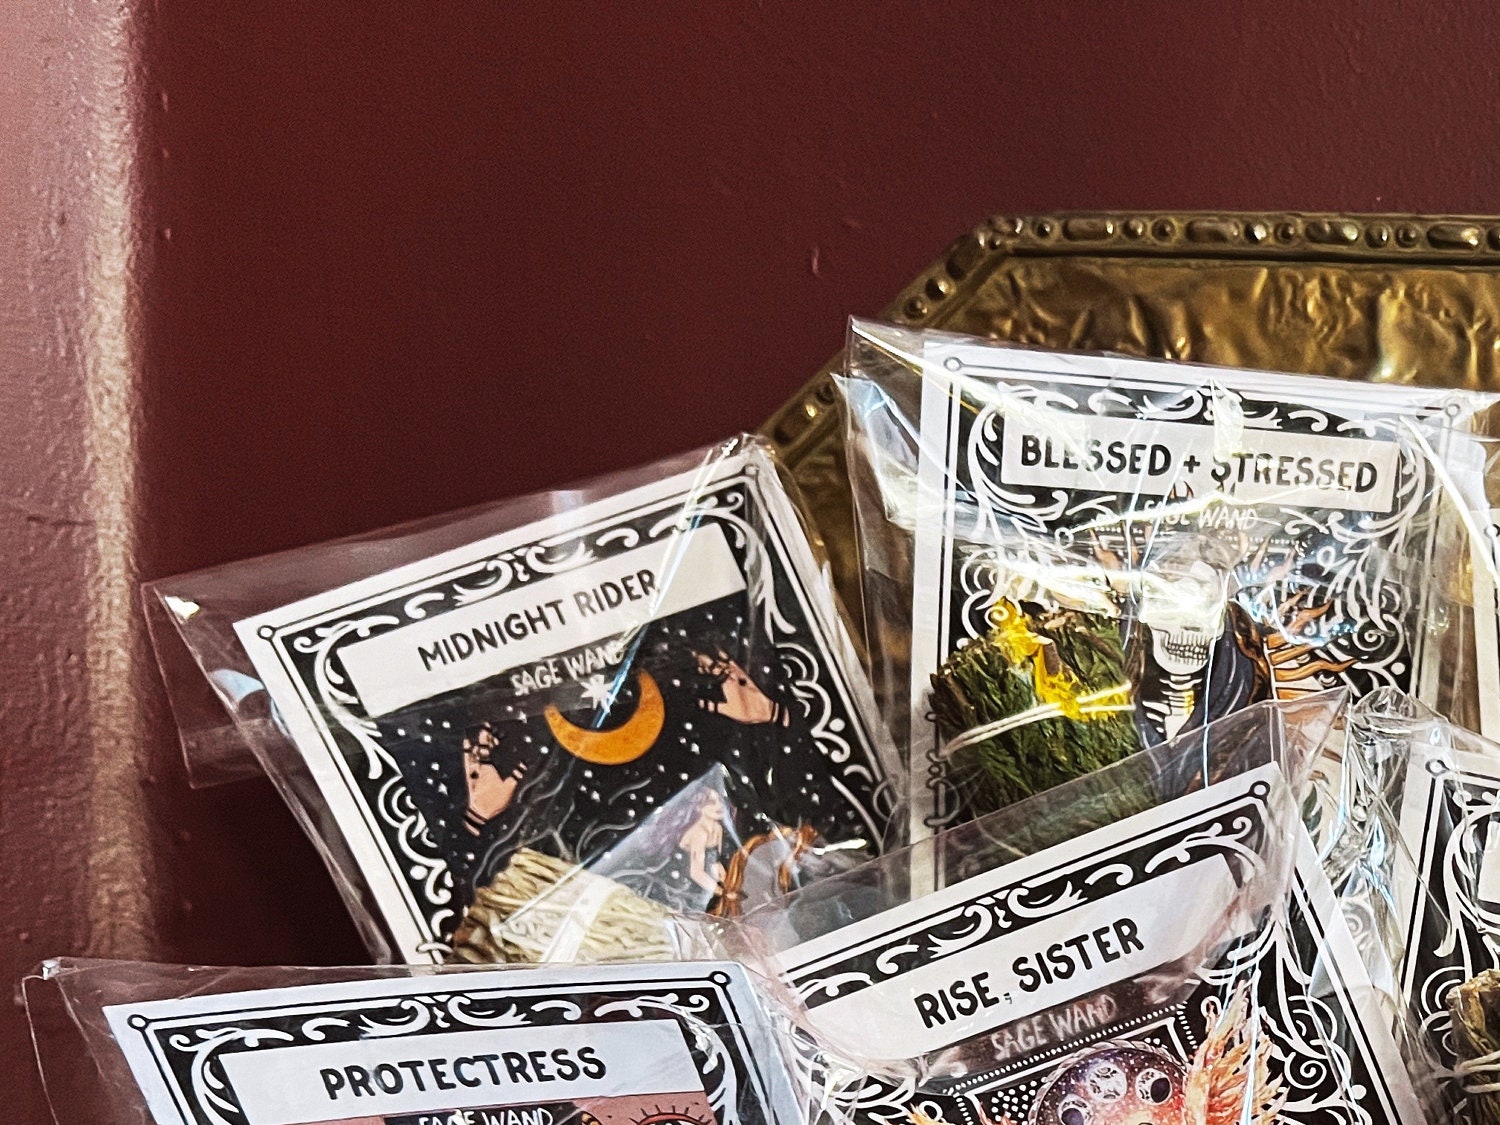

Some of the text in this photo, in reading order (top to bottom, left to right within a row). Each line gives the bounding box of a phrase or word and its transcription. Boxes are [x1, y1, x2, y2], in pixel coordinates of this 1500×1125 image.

[1020, 434, 1173, 477] BLESSED
[1210, 449, 1378, 493] STRESSED
[1198, 505, 1259, 530] WAND
[417, 569, 660, 671] MIDNIGHT RIDER
[510, 639, 625, 697] SAGE WAND
[1012, 917, 1145, 992] SISTER
[990, 993, 1118, 1060] SAGE WAND
[319, 1046, 607, 1100] PROTECTRESS
